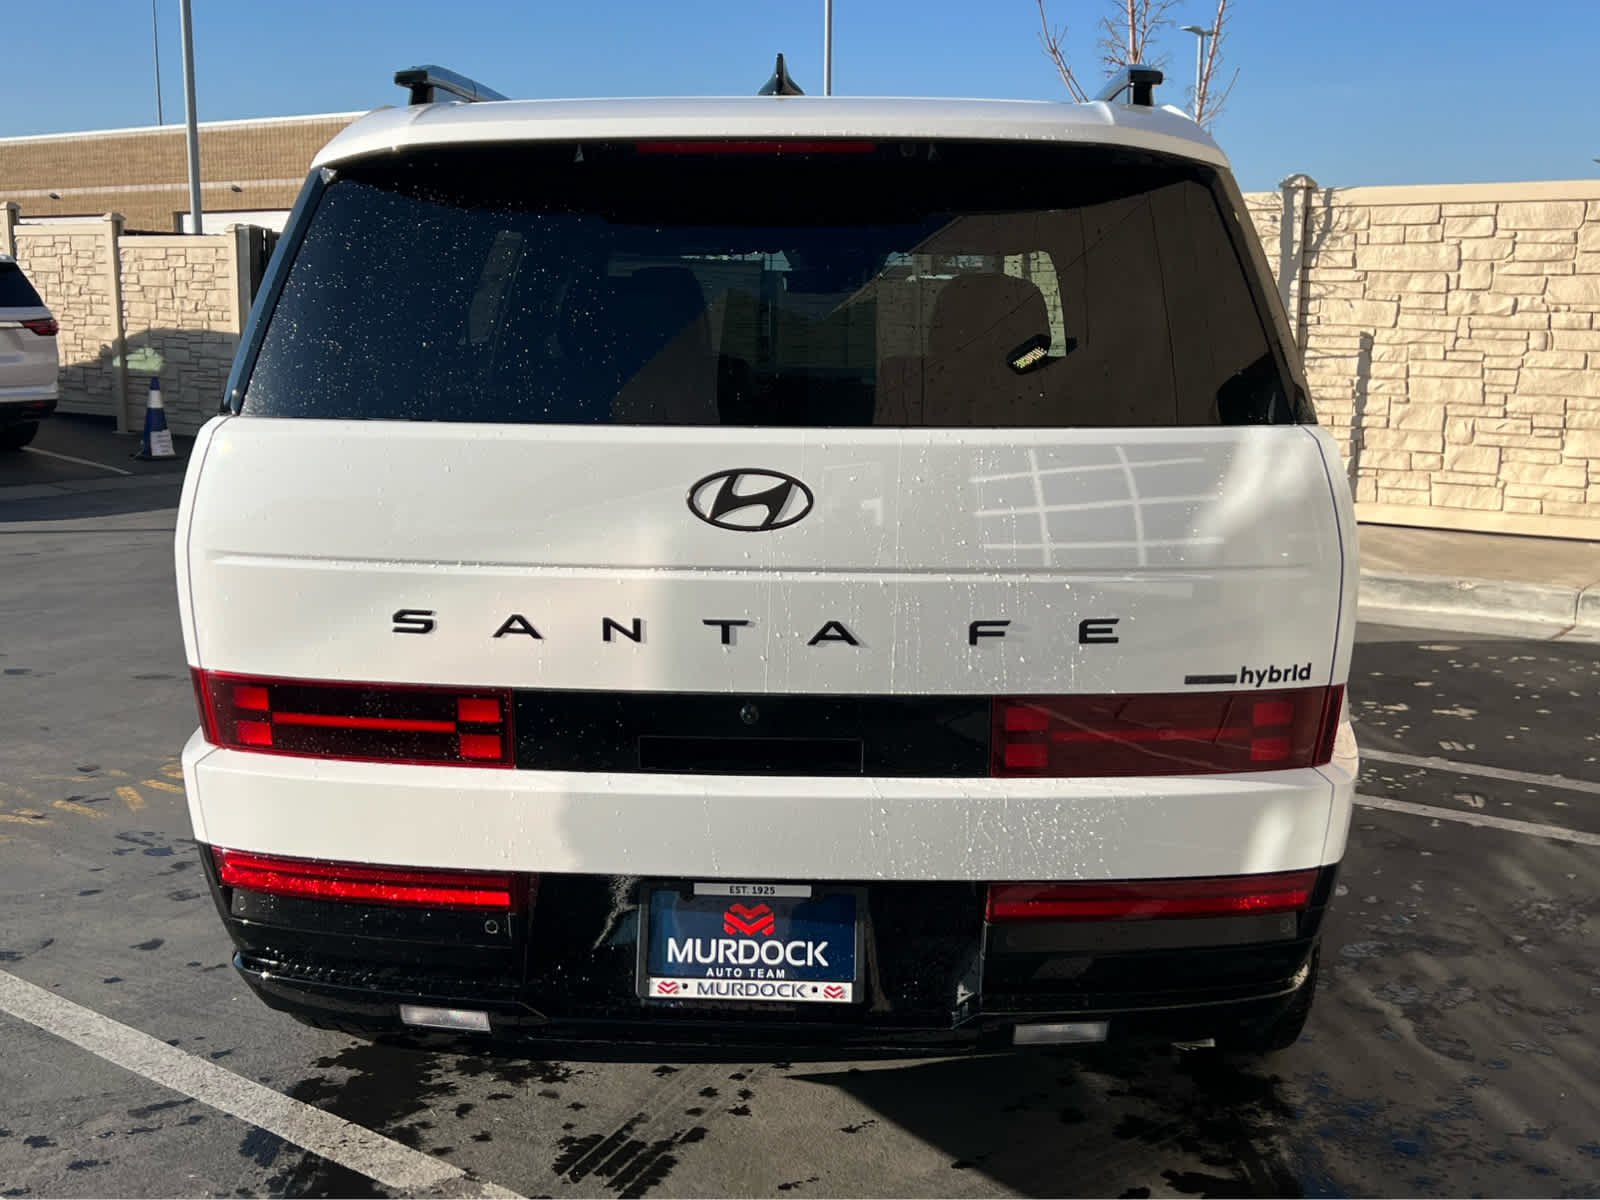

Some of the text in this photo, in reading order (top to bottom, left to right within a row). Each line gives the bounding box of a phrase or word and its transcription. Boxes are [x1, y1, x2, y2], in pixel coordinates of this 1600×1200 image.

[392, 608, 1121, 646] SANTA FE
[1240, 663, 1312, 687] hybrid
[751, 886, 776, 896] 1925
[666, 937, 829, 967] MURDOCK
[706, 967, 785, 979] AUTO TEAM
[696, 981, 808, 998] MURDOCK
